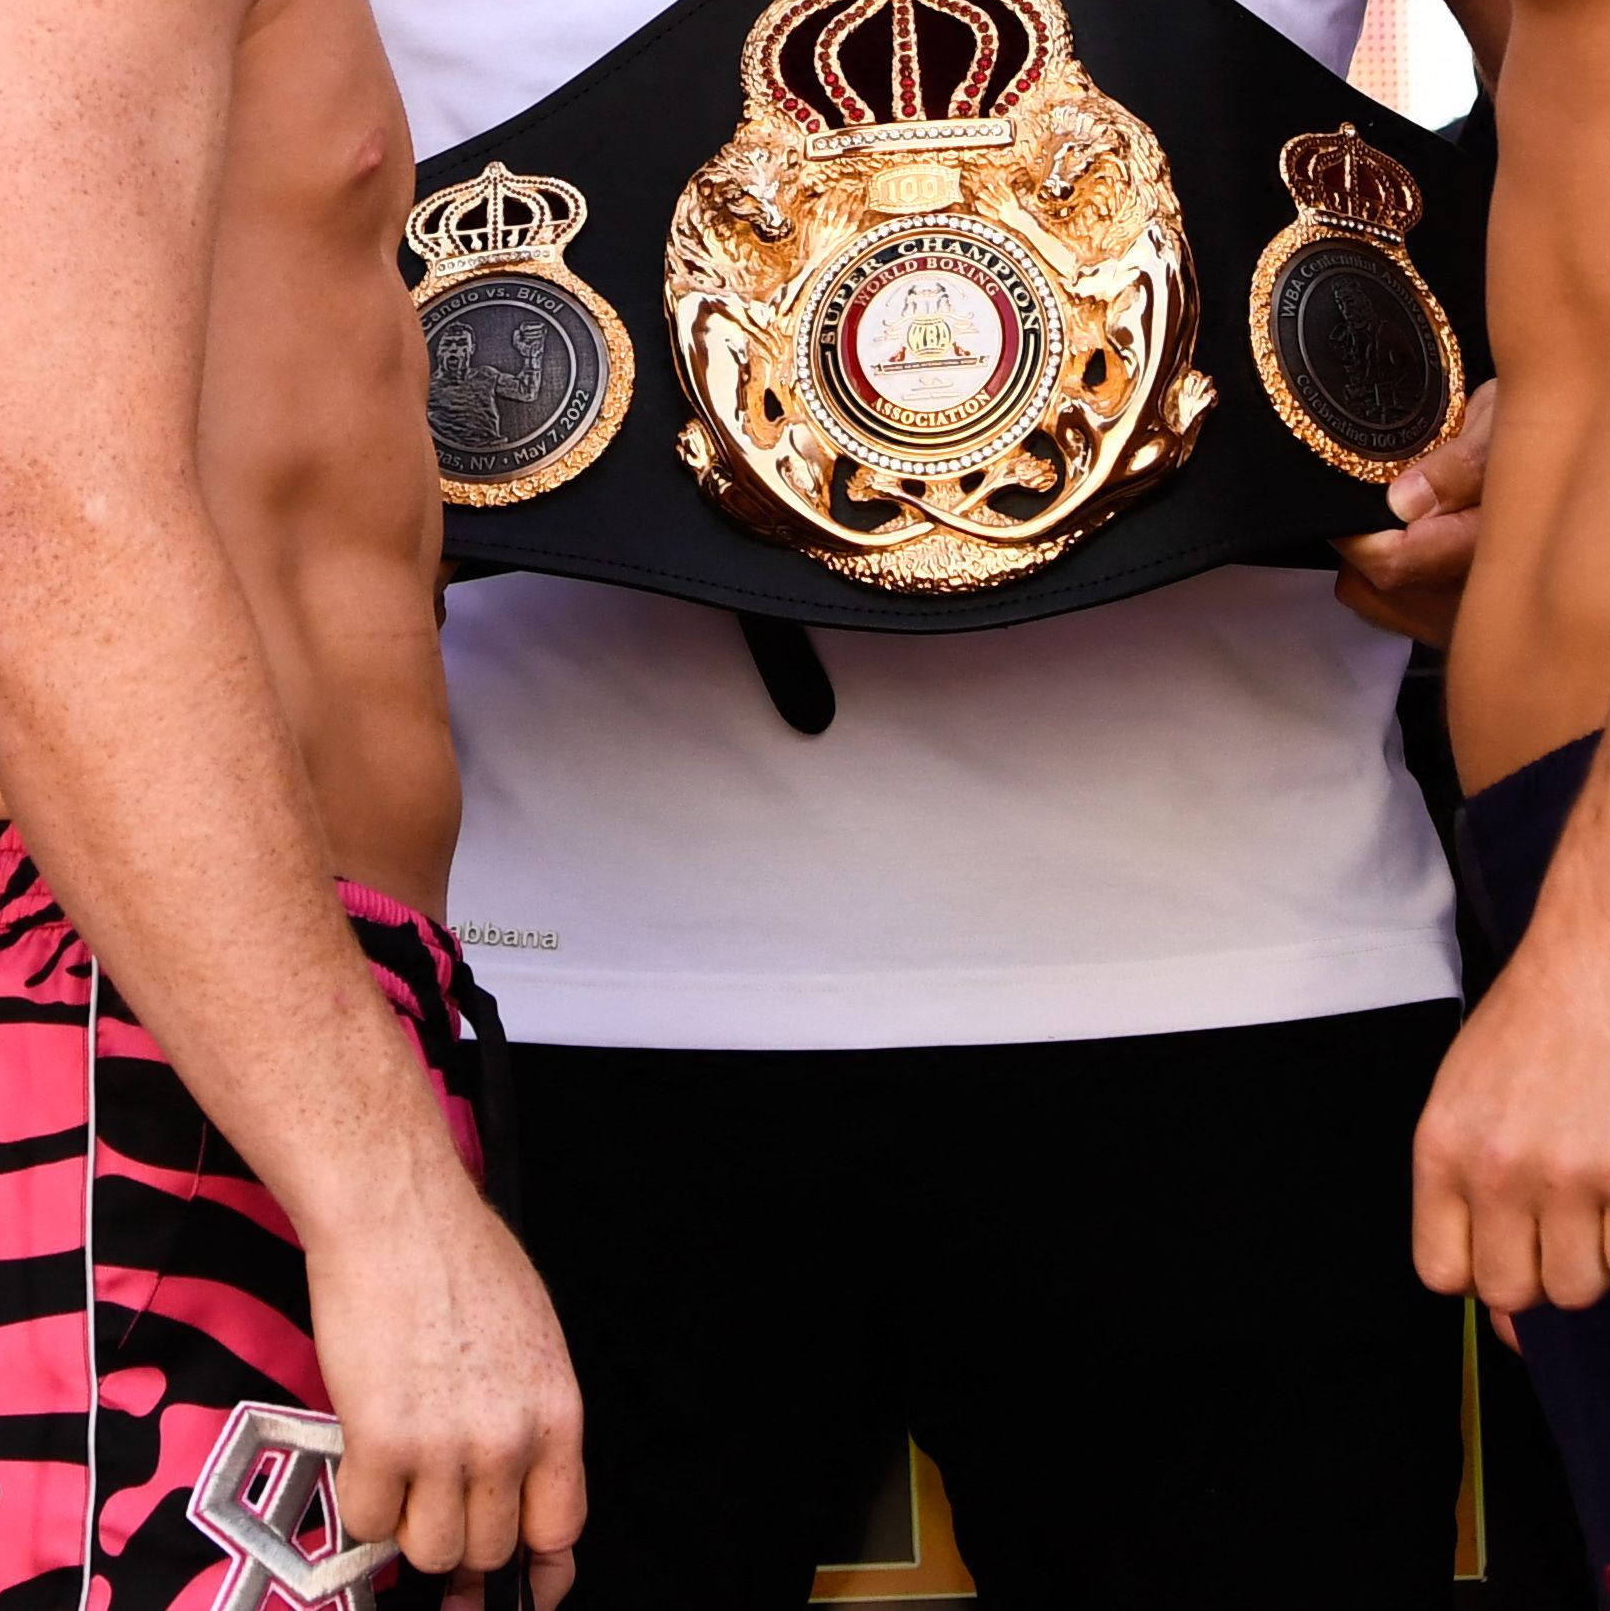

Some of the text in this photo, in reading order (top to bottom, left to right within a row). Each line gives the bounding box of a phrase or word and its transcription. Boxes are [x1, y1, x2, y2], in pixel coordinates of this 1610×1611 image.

[821, 237, 1040, 345] SUPER CHAMPION
[854, 257, 1000, 307] WORLD BOXING
[1281, 279, 1305, 318] WBA
[421, 287, 564, 330] Canelo vs. Bivol
[470, 456, 496, 471] NV
[514, 441, 547, 465] May
[547, 429, 565, 443] 7,
[561, 390, 589, 430] 2022
[871, 389, 991, 427] ASSOCIATION
[1297, 374, 1428, 448] Celebrating 100 Years
